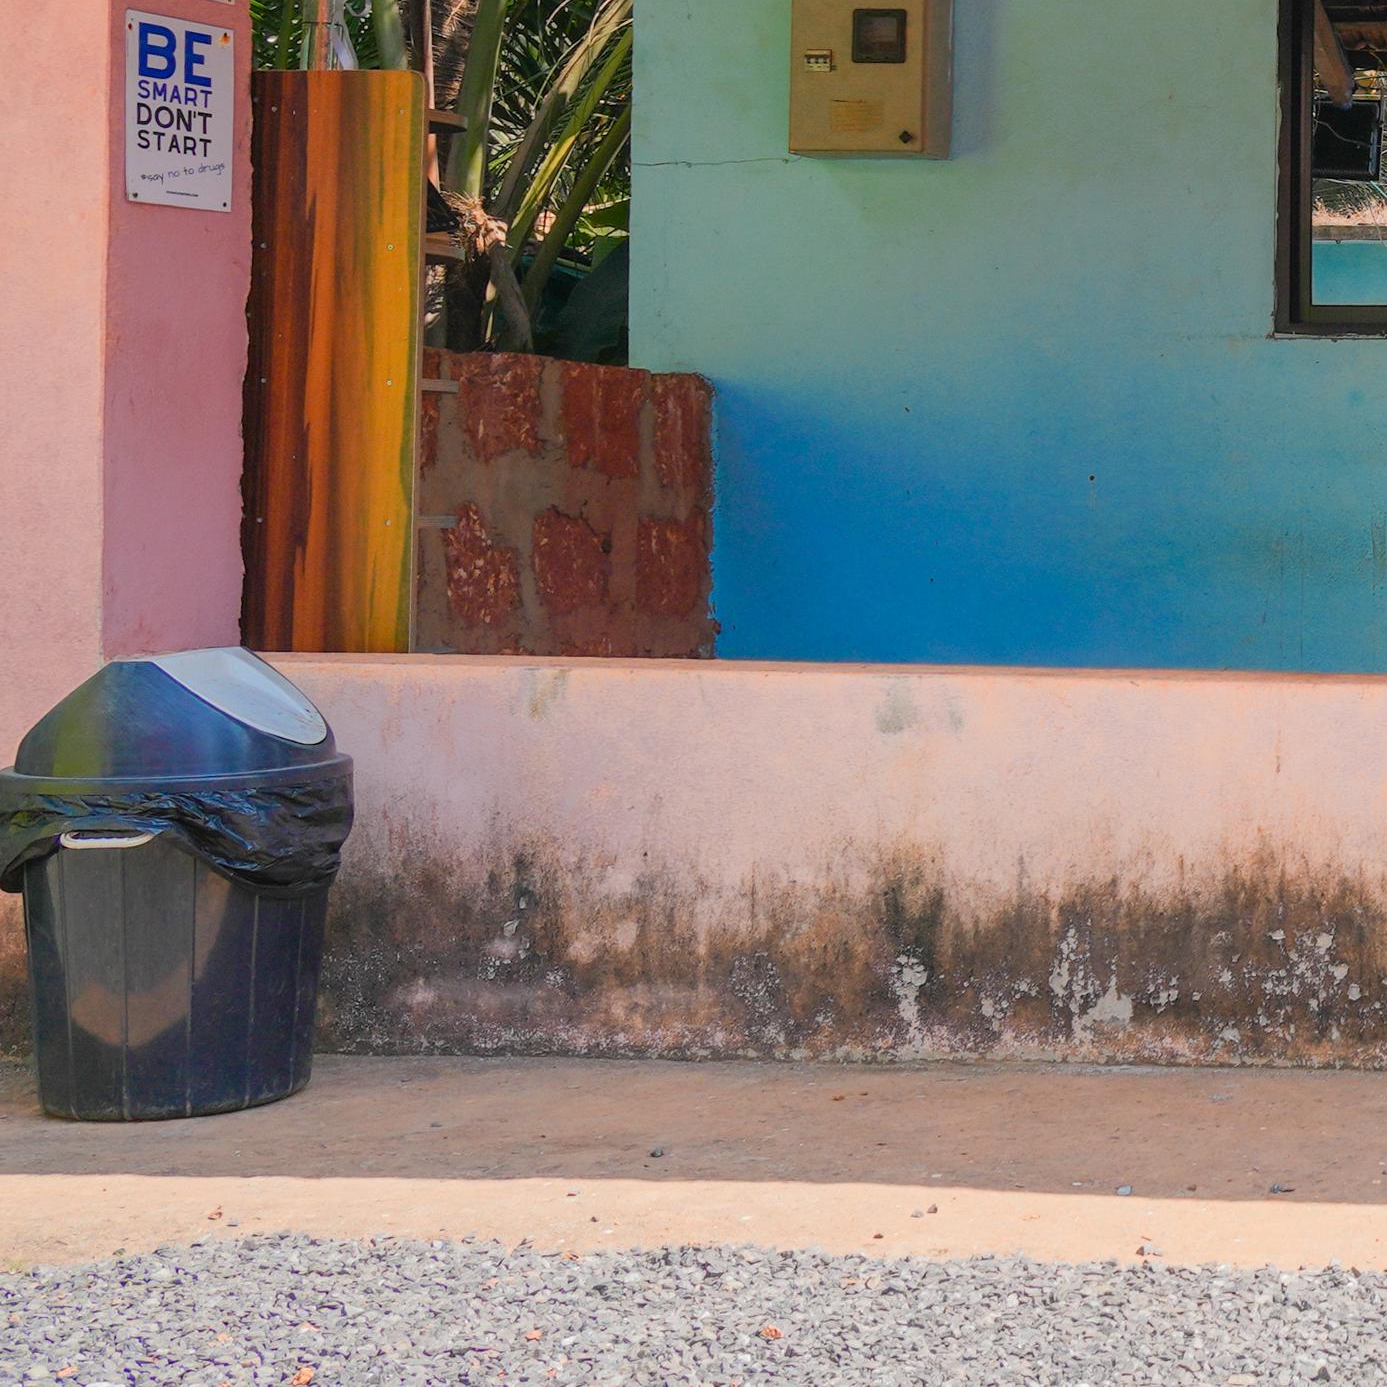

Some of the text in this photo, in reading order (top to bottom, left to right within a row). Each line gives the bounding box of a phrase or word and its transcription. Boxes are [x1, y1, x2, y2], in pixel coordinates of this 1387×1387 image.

[139, 21, 212, 88] BE
[138, 79, 213, 108] SMART
[137, 102, 213, 134] DON'T
[137, 129, 212, 157] START
[168, 170, 180, 179] no
[184, 166, 195, 176] to
[198, 162, 225, 176] drugs
